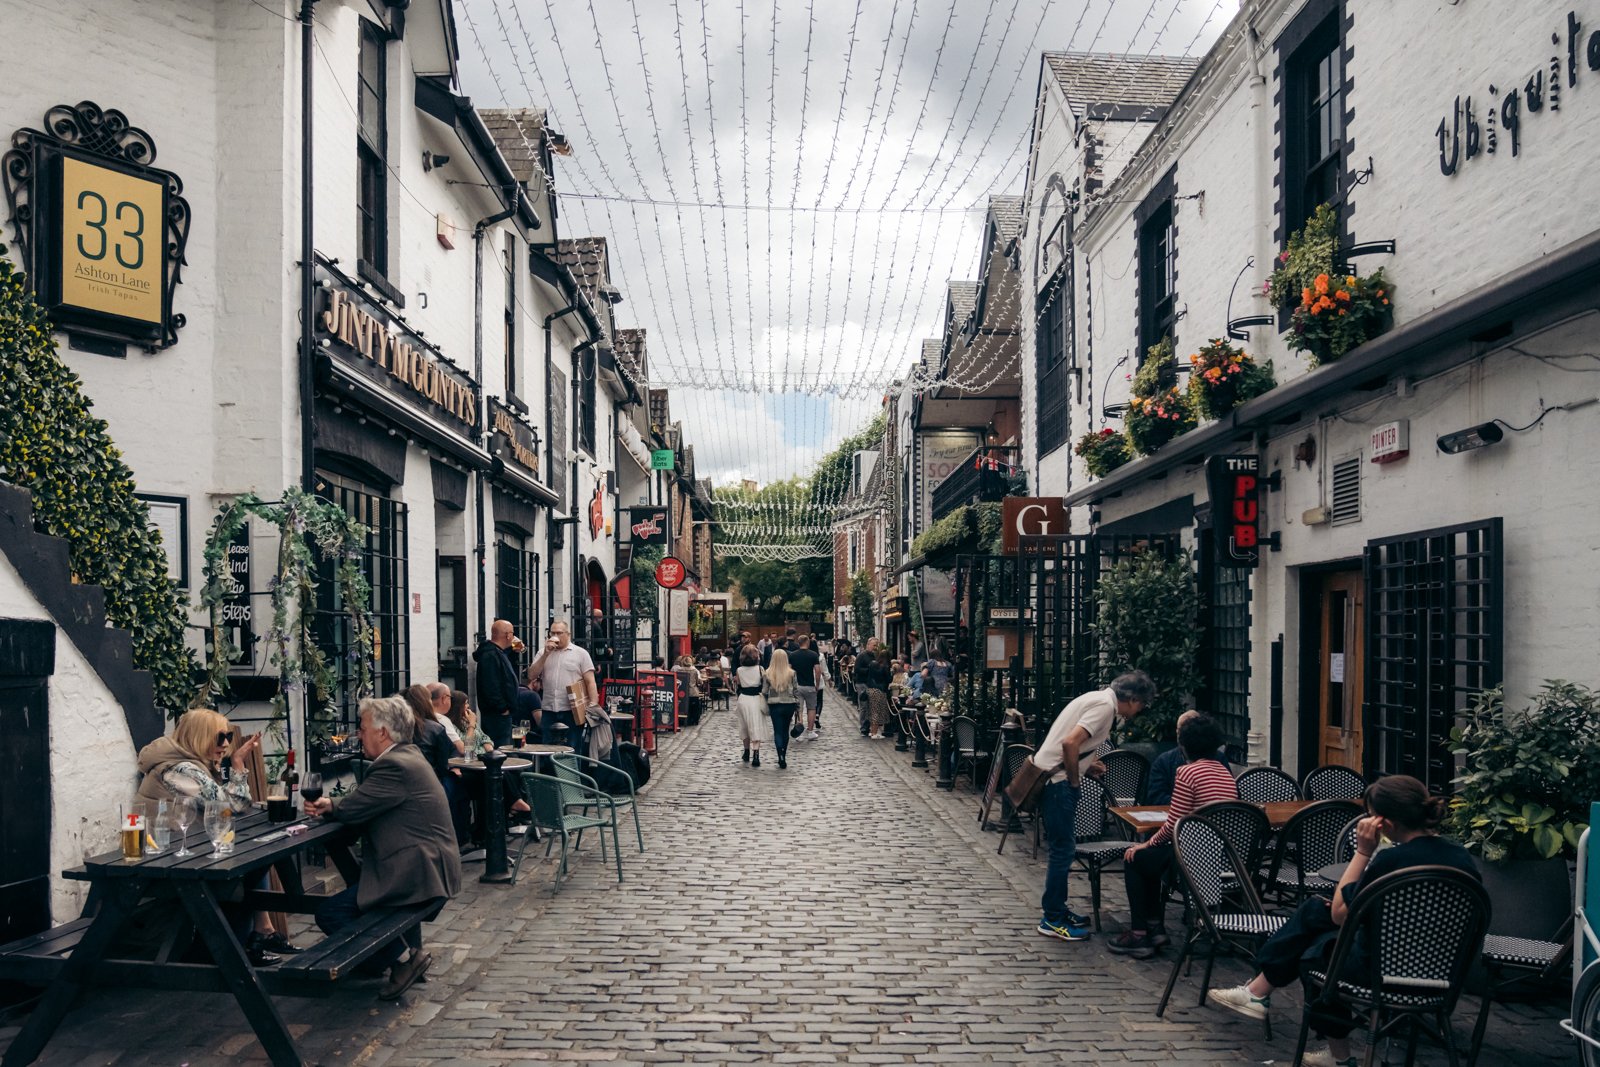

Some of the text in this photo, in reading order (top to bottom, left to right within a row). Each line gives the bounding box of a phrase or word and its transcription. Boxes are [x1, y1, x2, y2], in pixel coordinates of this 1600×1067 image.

[77, 190, 144, 270] 33
[74, 262, 151, 290] Ashton Lane
[88, 284, 139, 301] Irish Tapas
[322, 288, 389, 369] JINTY
[1371, 427, 1396, 452] POINTER
[1226, 458, 1258, 471] THE
[1016, 504, 1052, 536] G
[1233, 475, 1257, 548] PUB
[227, 542, 250, 555] lease
[229, 556, 249, 574] ind
[222, 602, 251, 626] steps
[992, 609, 1027, 617] OYSTES
[651, 689, 674, 703] EER
